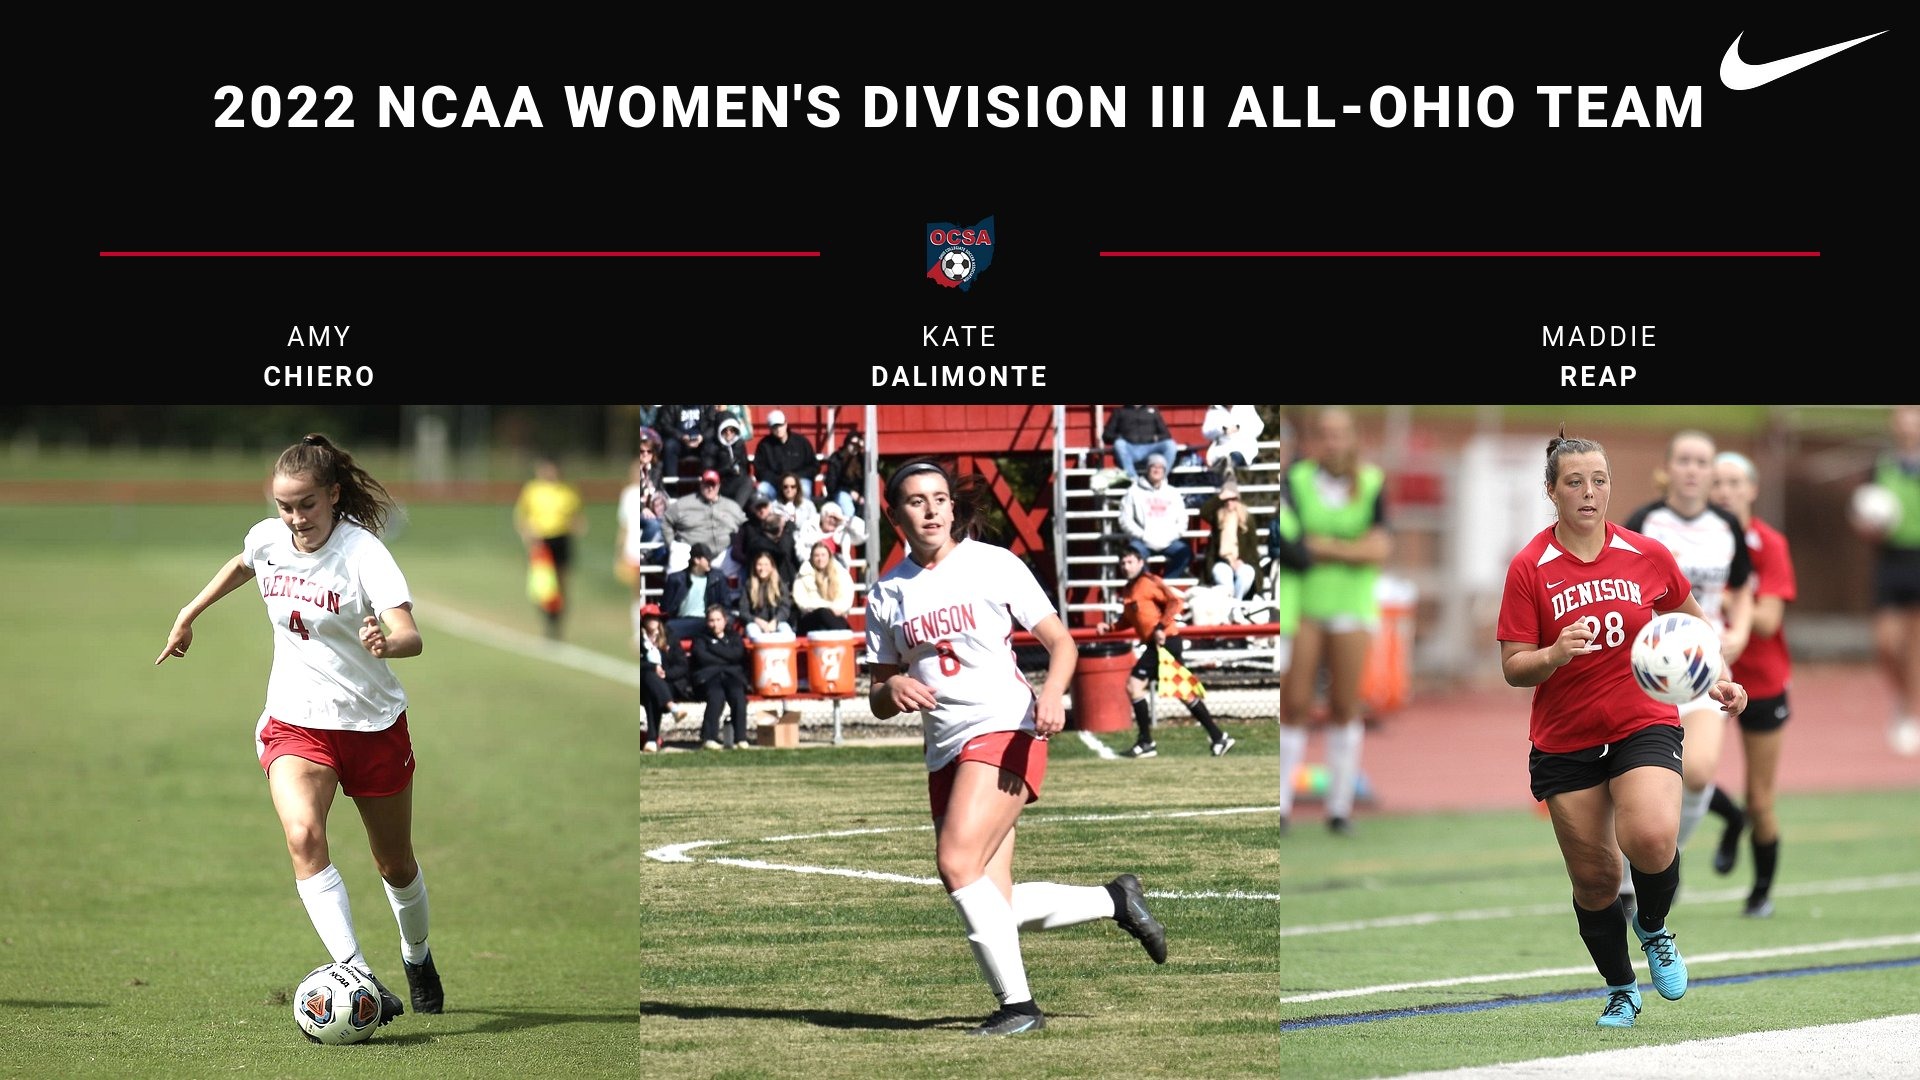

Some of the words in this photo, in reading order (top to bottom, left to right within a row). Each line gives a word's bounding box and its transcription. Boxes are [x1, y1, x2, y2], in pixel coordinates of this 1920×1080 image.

[1551, 578, 1643, 621] DENISON
[289, 610, 310, 641] 4
[902, 603, 977, 650] DENISON
[1584, 611, 1625, 649] 28
